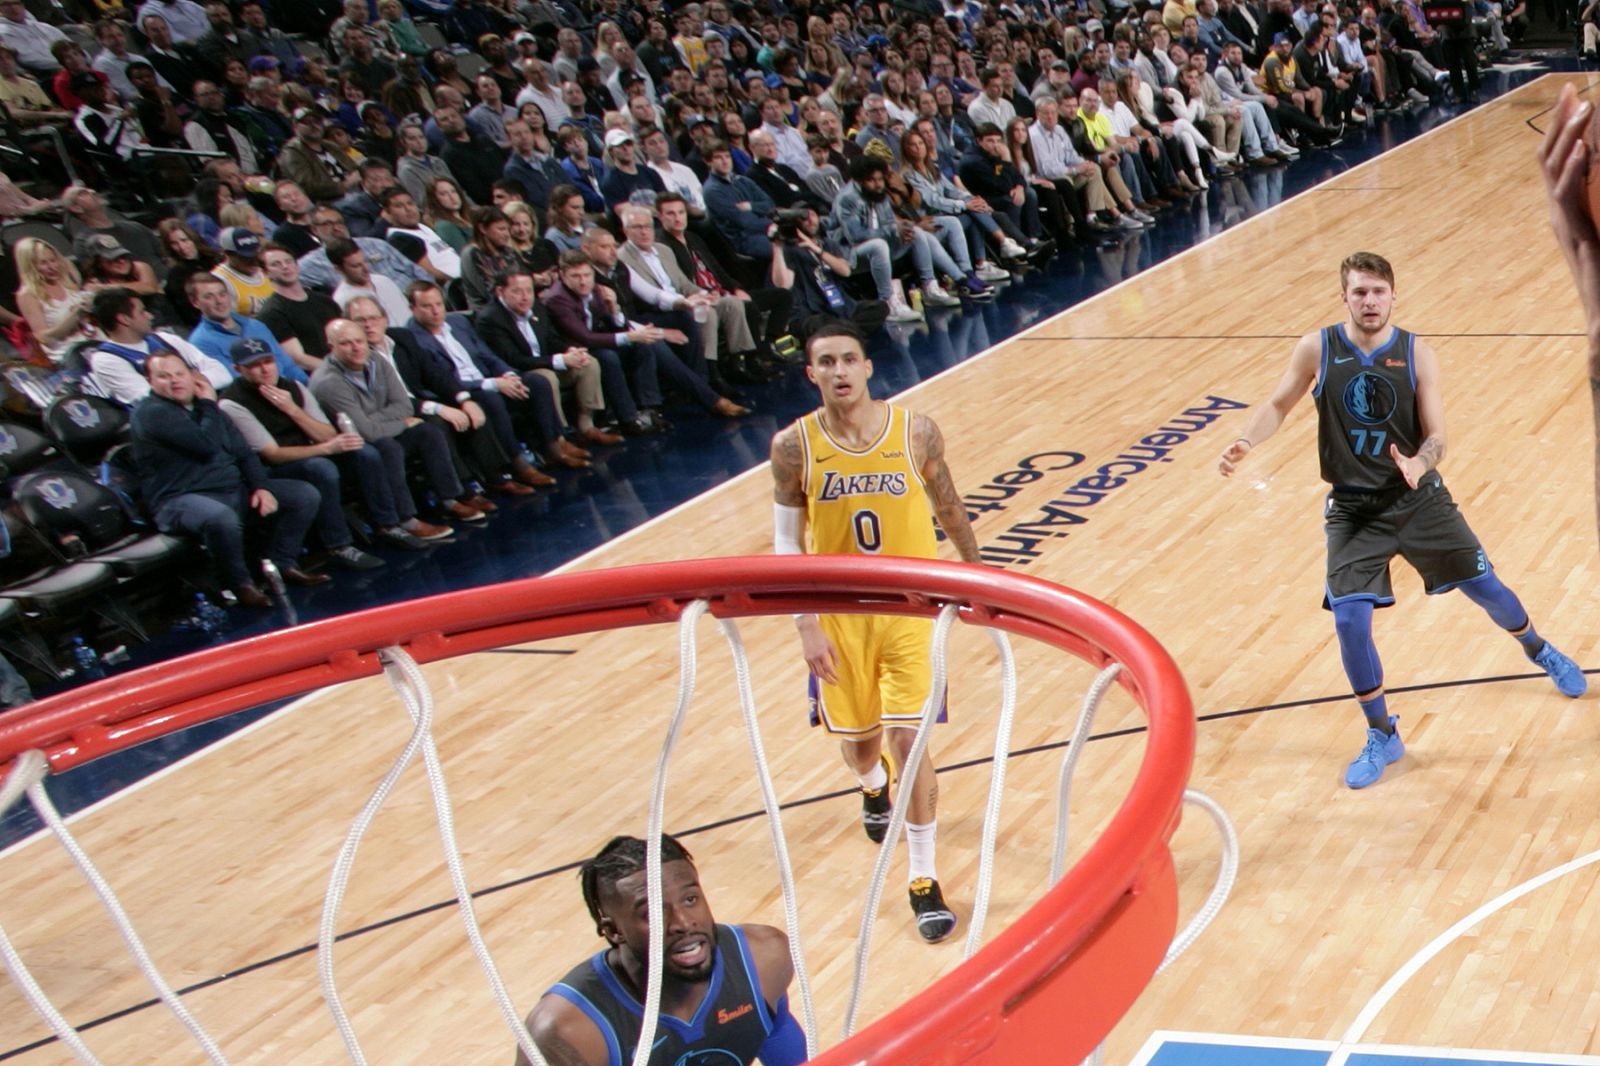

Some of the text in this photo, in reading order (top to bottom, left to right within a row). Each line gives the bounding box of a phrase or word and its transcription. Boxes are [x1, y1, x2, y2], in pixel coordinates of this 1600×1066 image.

[1350, 429, 1387, 456] 77
[815, 470, 908, 501] LAKERS
[853, 509, 882, 553] 0
